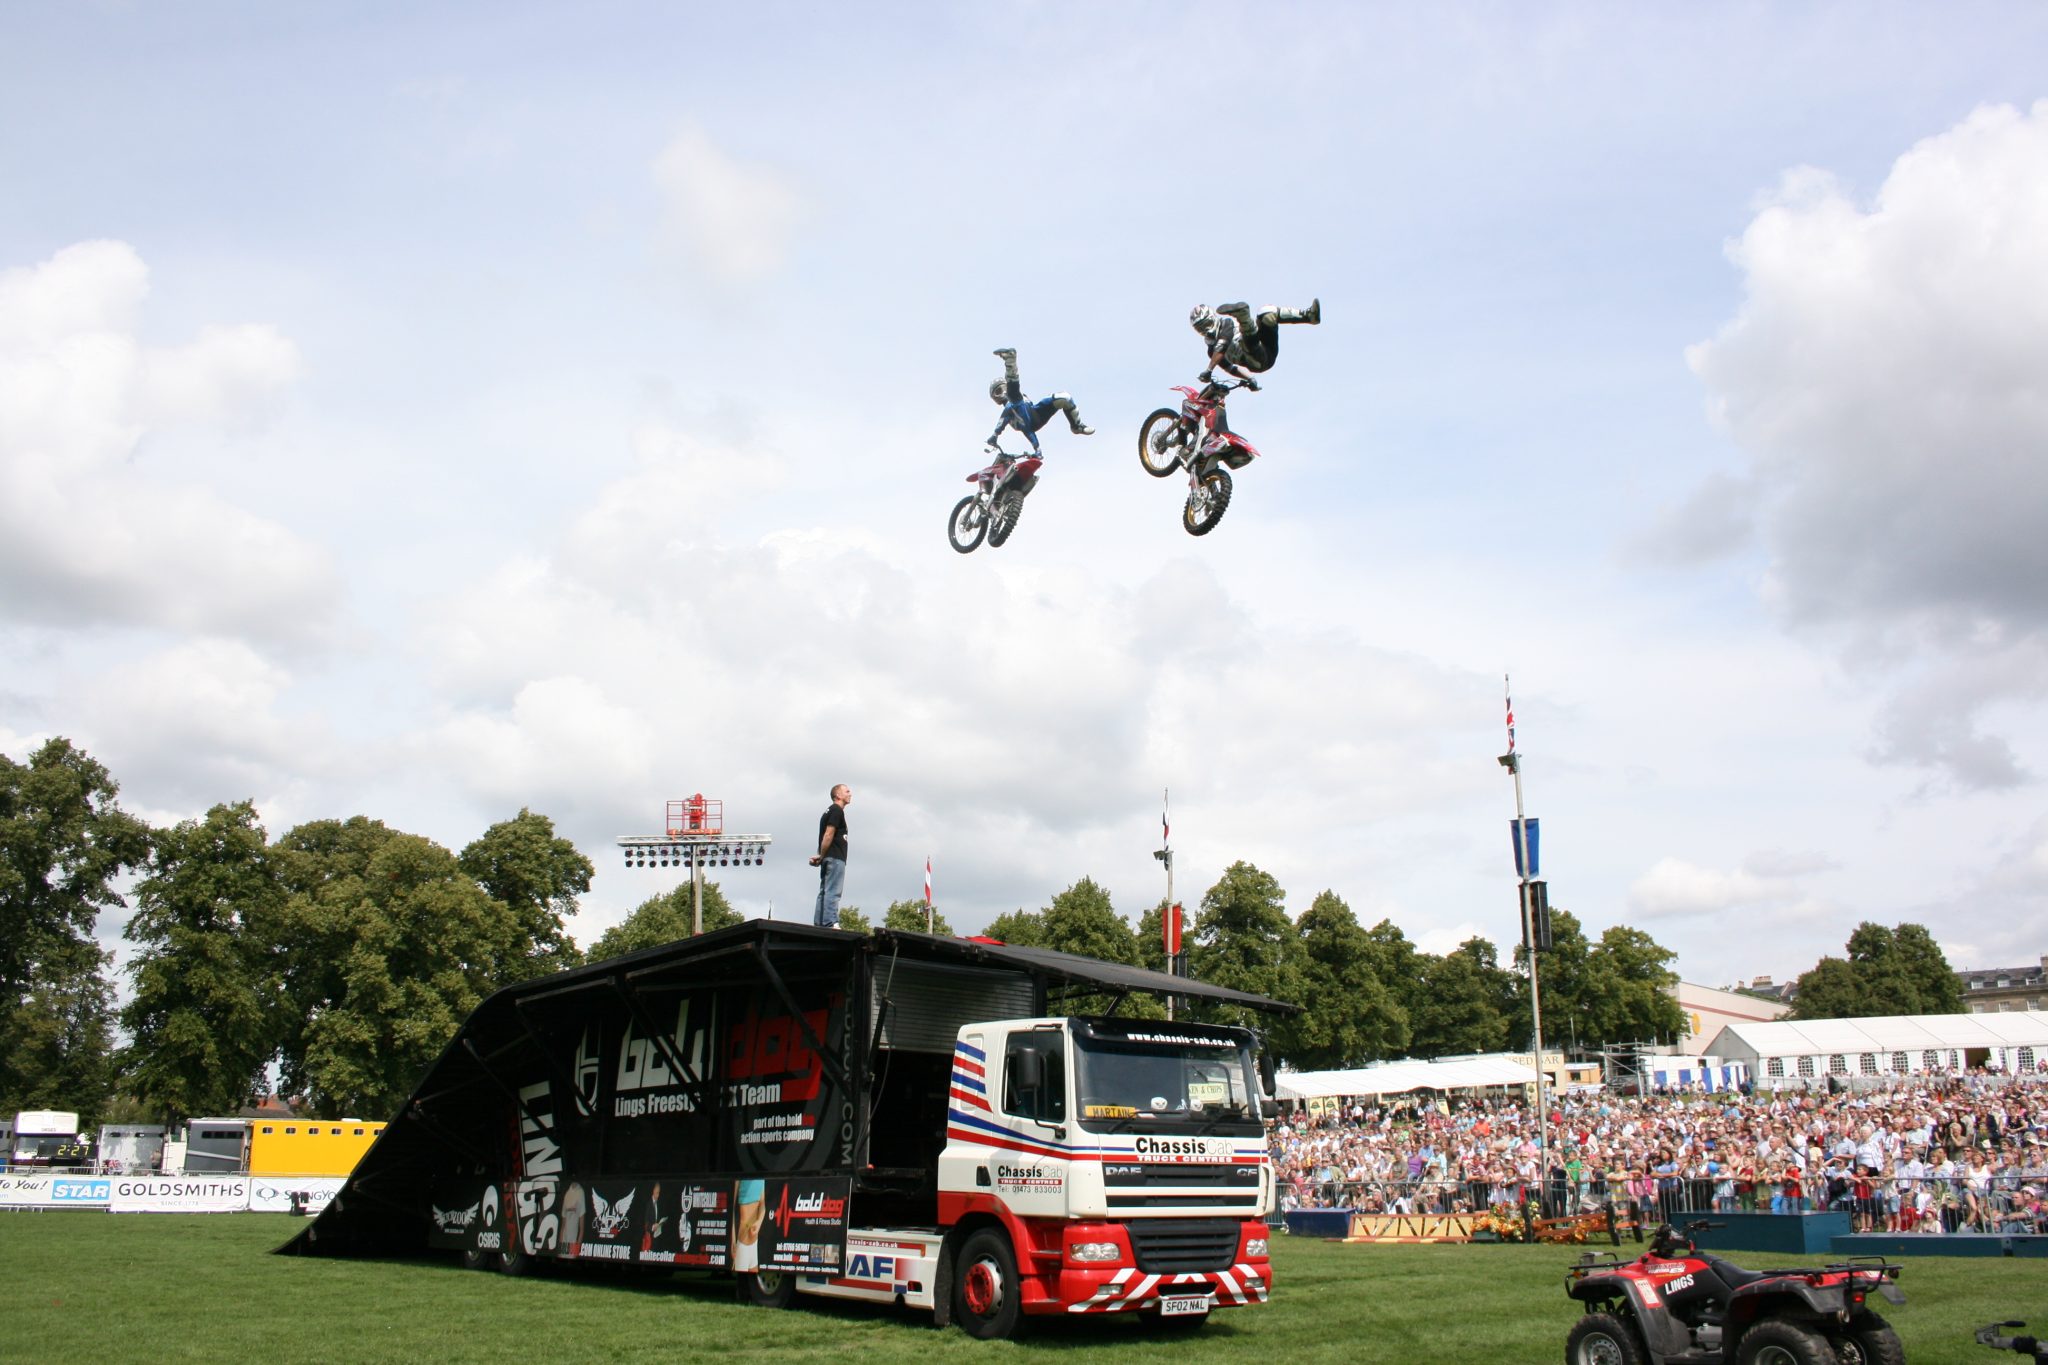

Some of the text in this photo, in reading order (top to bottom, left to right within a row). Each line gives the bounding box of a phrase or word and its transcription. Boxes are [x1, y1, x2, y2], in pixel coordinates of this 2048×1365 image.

[1127, 1033, 1236, 1047] www.chassis-cab.co.uk
[1541, 1055, 1560, 1065] AR
[615, 1097, 645, 1117] Lings
[648, 1092, 701, 1114] Freesty
[740, 1084, 781, 1106] Team
[754, 1118, 767, 1130] part
[768, 1117, 775, 1128] of
[775, 1116, 785, 1127] the
[741, 1128, 814, 1144] action sports company
[57, 1145, 89, 1156] 2:27
[1136, 1137, 1233, 1155] ChassisCab
[1137, 1155, 1233, 1163] TRUCK CENTRES
[519, 1080, 563, 1256] LINGS
[998, 1164, 1062, 1178] ChassisCab
[1105, 1166, 1142, 1176] DAF
[1236, 1168, 1258, 1177] CF
[15, 1180, 48, 1190] You!
[54, 1184, 109, 1198] STAR
[118, 1183, 244, 1197] GOLDSMITHS
[1013, 1185, 1031, 1193] 01473
[284, 1190, 337, 1200] SNGYO
[795, 1192, 845, 1218] bolddog
[478, 1232, 500, 1248] OSIRIS
[593, 1243, 612, 1258] ONLINE
[612, 1245, 631, 1260] STORE
[847, 1254, 893, 1278] AF
[1665, 1274, 1694, 1295] LINGS
[1166, 1300, 1204, 1311] SF02 NAL
